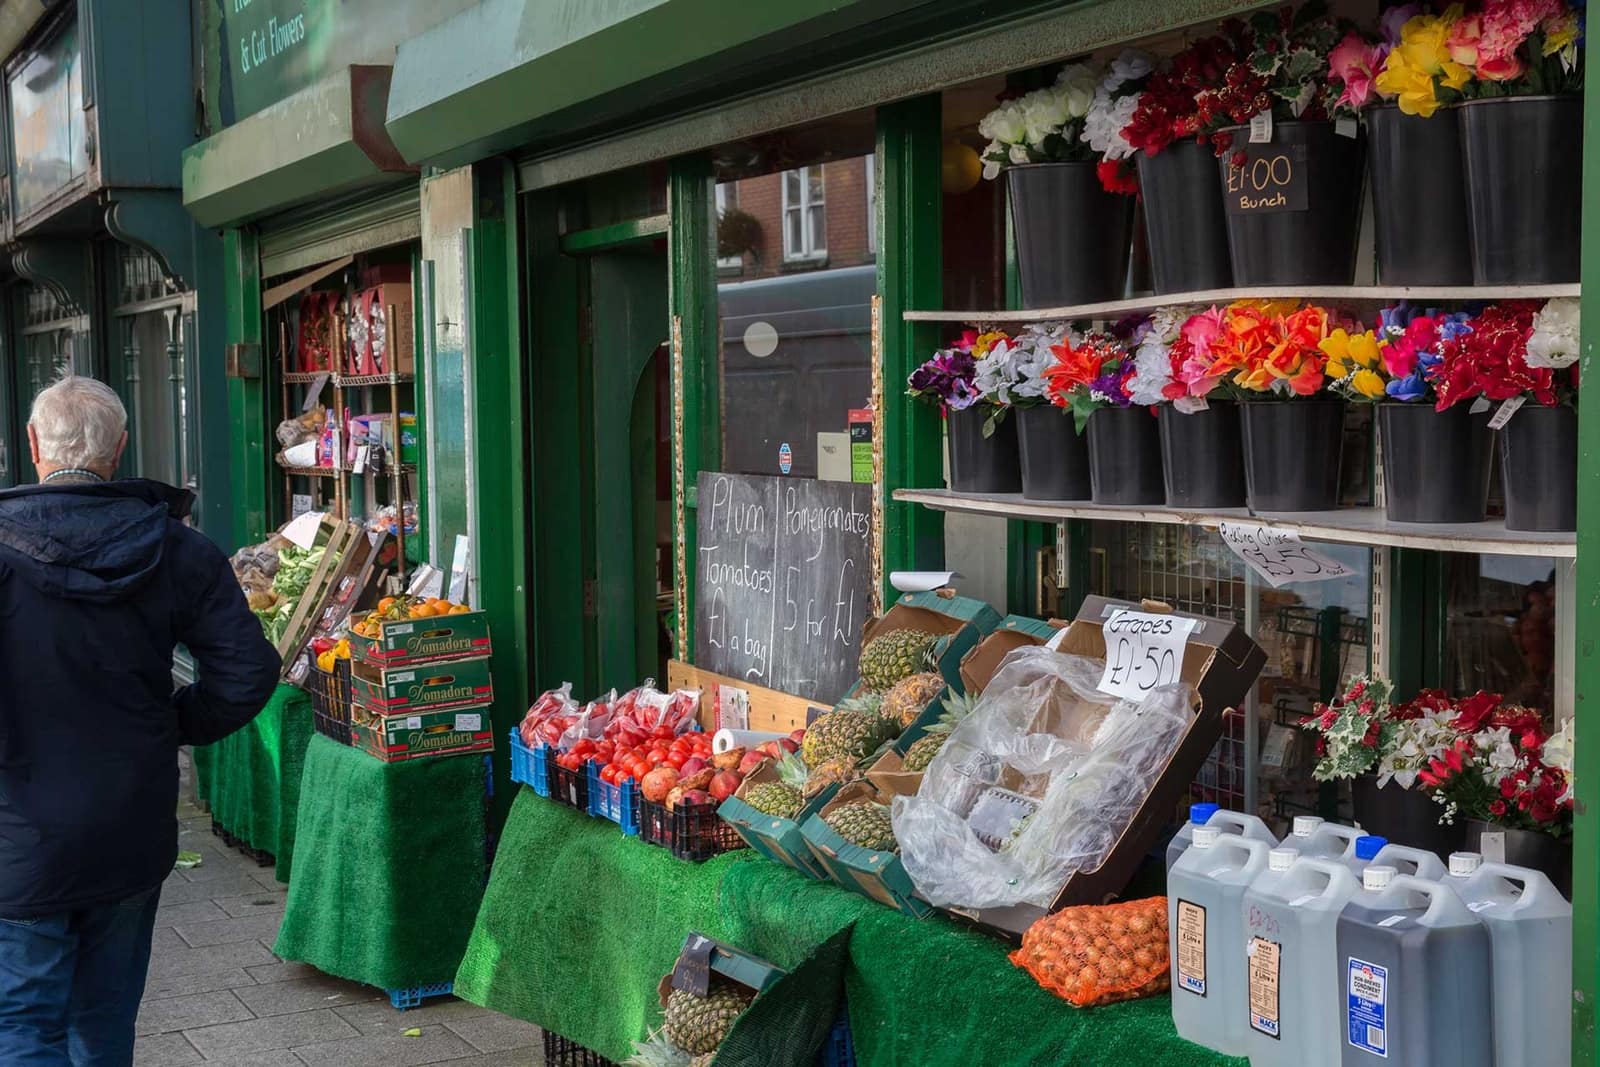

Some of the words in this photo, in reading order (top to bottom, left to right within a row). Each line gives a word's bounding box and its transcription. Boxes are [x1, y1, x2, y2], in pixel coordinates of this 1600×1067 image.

[240, 37, 250, 74] &
[251, 28, 267, 67] Cut
[268, 13, 304, 56] Flowers
[1240, 192, 1286, 209] Bunch
[710, 476, 765, 534] Plum
[785, 486, 870, 562] Pomegranates
[700, 538, 771, 593] Tomatoes
[708, 586, 726, 649] £1
[730, 635, 740, 650] a
[744, 618, 766, 677] bag
[783, 566, 800, 631] 5
[806, 599, 827, 645] for
[833, 558, 854, 646] £1
[1109, 611, 1173, 648] Grapes
